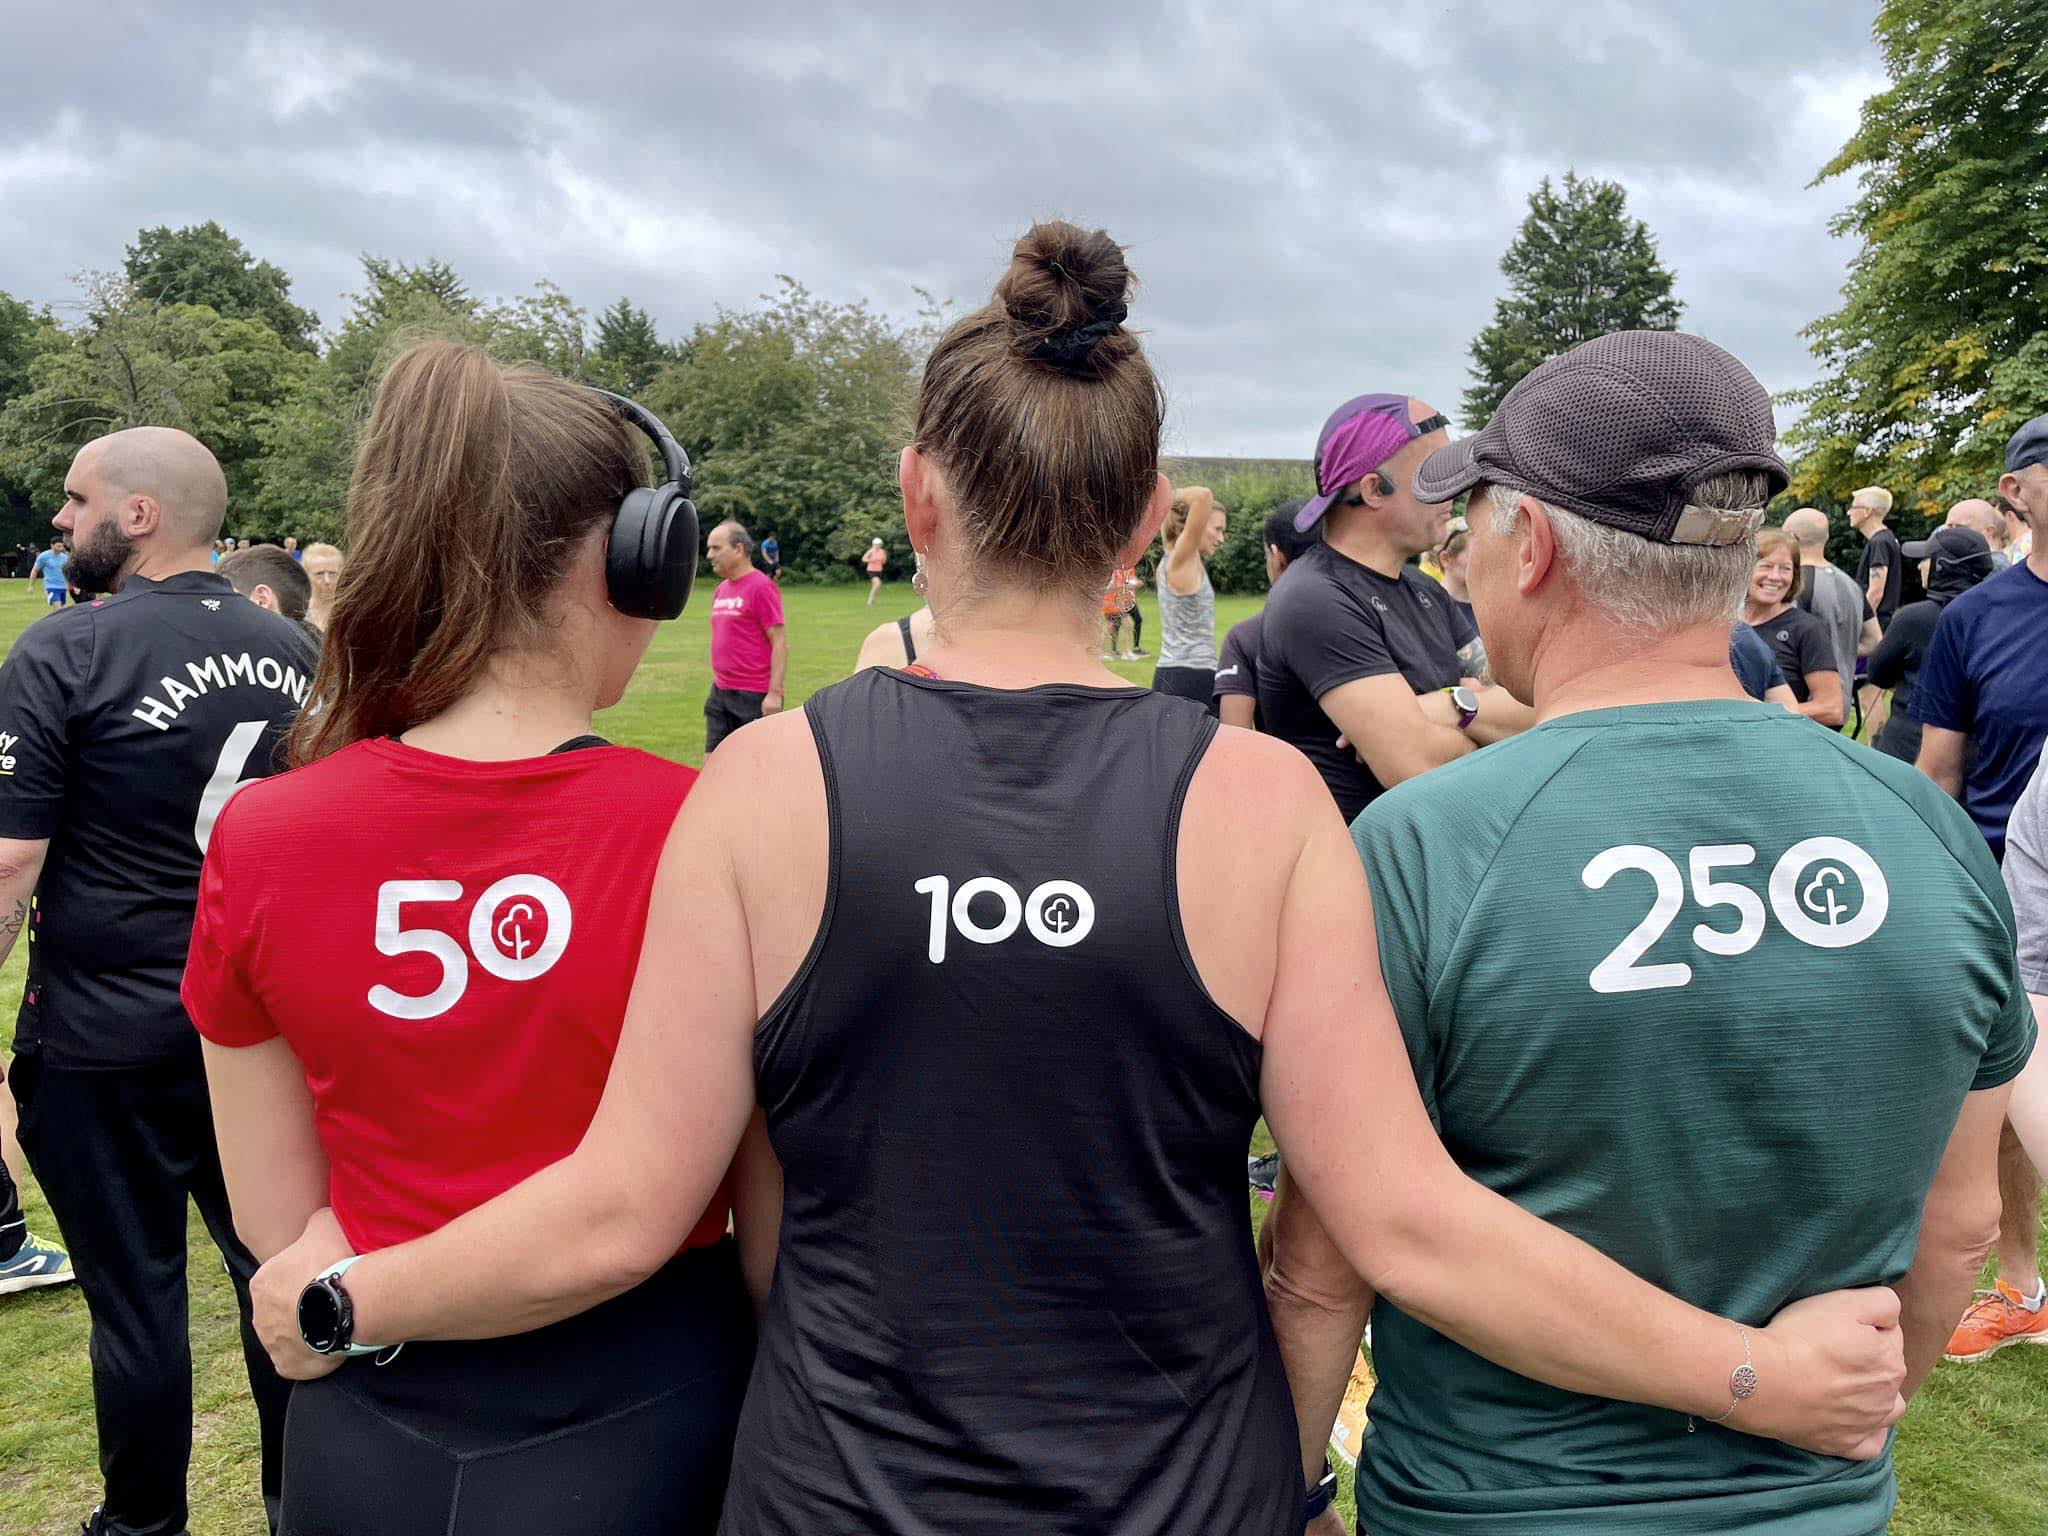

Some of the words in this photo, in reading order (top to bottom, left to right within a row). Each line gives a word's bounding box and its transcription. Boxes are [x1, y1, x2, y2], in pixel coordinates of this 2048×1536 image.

[367, 873, 572, 1020] 50
[914, 874, 1095, 965] 100
[1581, 836, 1889, 993] 250
